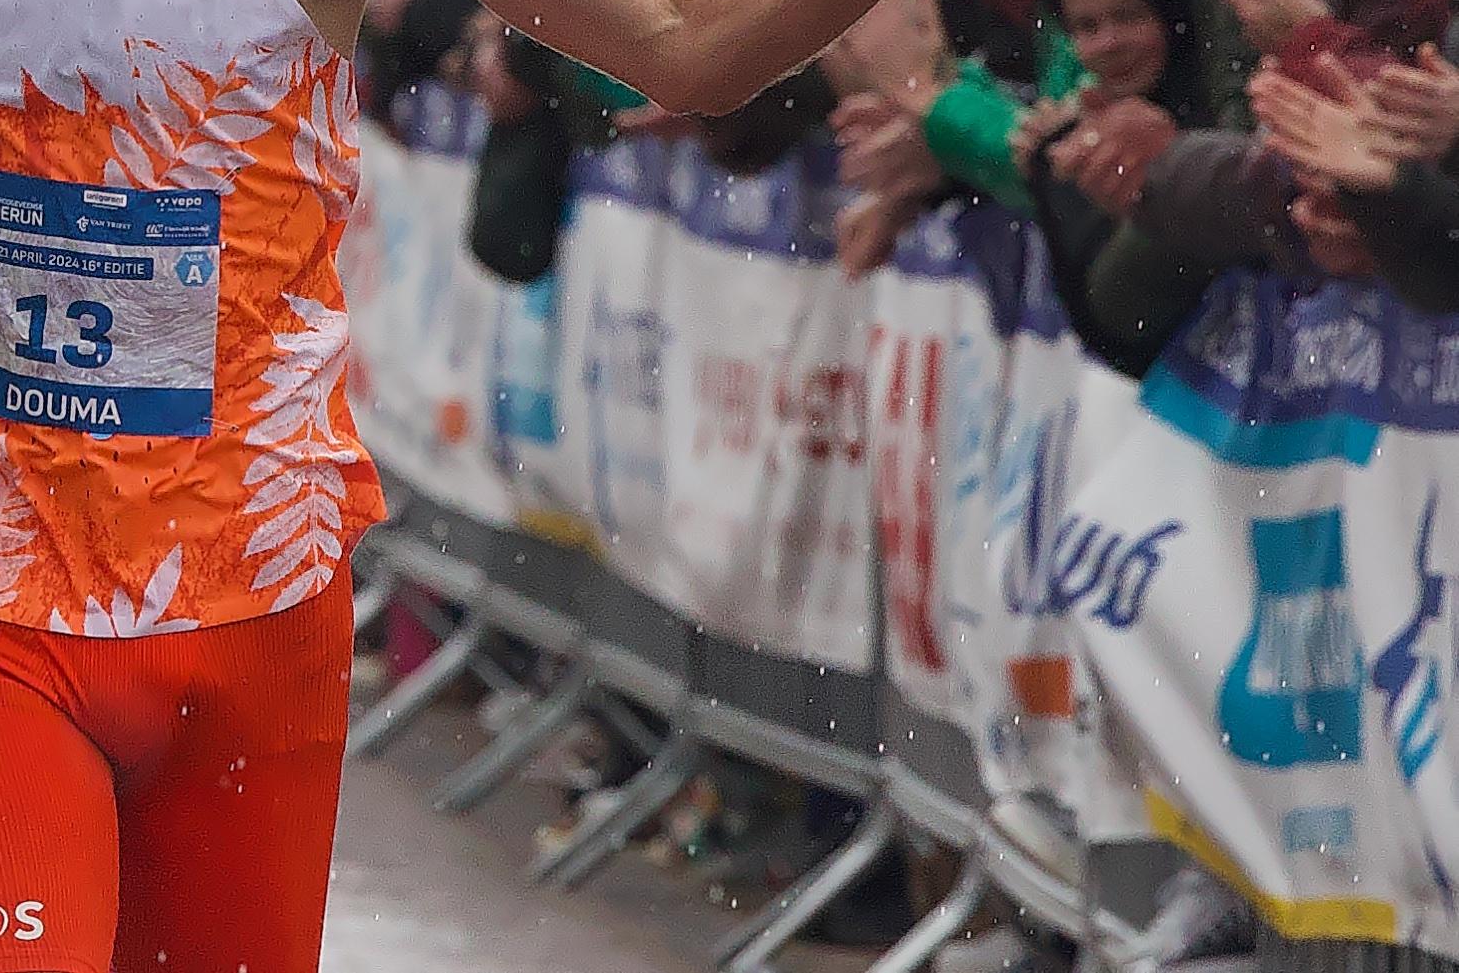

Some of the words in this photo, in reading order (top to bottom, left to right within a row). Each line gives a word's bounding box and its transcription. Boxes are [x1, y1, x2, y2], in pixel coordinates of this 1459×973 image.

[11, 250, 45, 266] APRIL
[48, 254, 80, 269] 2024
[103, 261, 145, 275] EDITIE
[185, 264, 203, 284] A
[15, 294, 113, 369] 13
[6, 383, 121, 425] DOUMA
